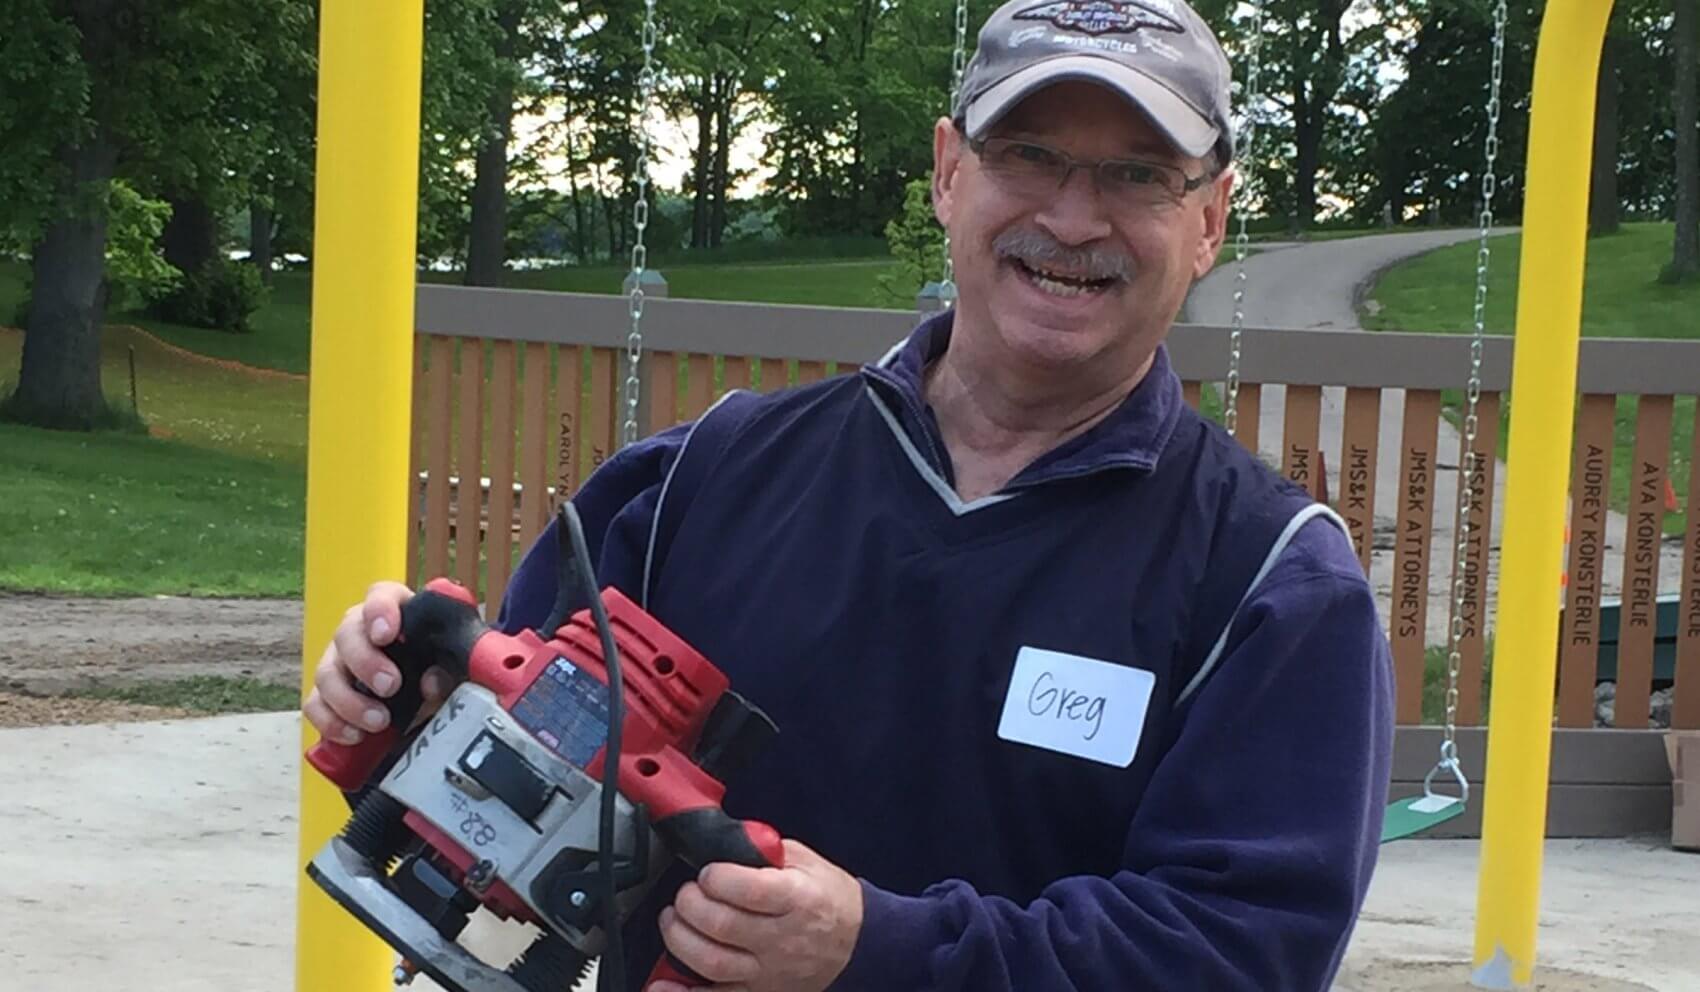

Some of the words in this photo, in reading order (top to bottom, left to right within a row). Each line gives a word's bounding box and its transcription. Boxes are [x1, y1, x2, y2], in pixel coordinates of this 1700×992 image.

[1348, 444, 1368, 509] JMS&K
[1408, 448, 1427, 512] JMS&K
[1582, 444, 1604, 523] AUDREY
[1641, 461, 1659, 505] AVA
[1399, 520, 1422, 637] ATTORNEYS
[1573, 530, 1597, 646] KONSTERLIE
[1630, 512, 1655, 627] KONSTERLIE
[394, 695, 465, 780] JACK
[1028, 671, 1106, 741] Greg
